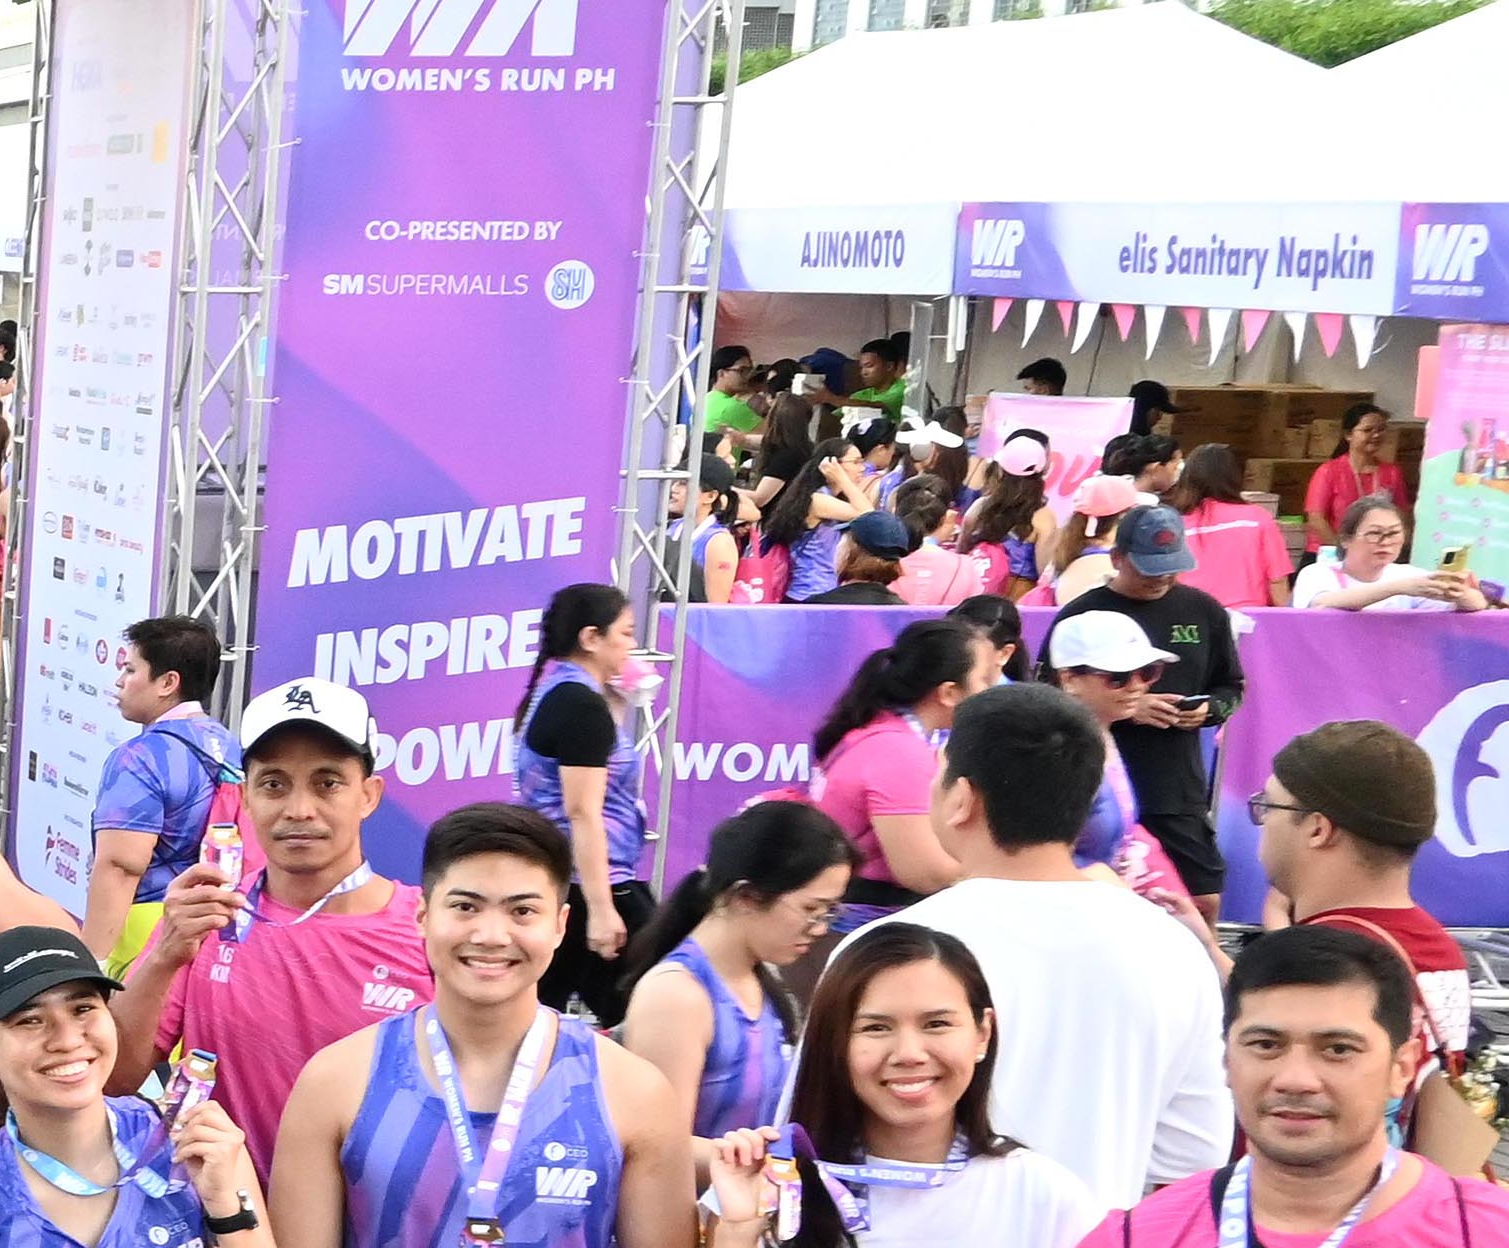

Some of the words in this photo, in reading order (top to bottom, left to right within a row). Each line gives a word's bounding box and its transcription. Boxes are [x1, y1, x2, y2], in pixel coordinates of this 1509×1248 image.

[340, 68, 491, 91] WOMEN'S
[501, 68, 564, 91] RUN
[574, 68, 615, 91] PH
[365, 220, 531, 241] CO-PRESENTED
[534, 220, 562, 241] BY
[800, 230, 905, 268] AJINOMOTO
[971, 219, 1025, 267] WR
[1119, 232, 1158, 276] elis
[1164, 233, 1269, 290] Sanitary
[1277, 234, 1375, 291] Napkin
[1412, 223, 1490, 282] WR
[287, 496, 586, 588] MOTIVATE
[313, 608, 544, 688] INSPIRE
[673, 742, 810, 782] WOM
[363, 982, 415, 1011] WR
[536, 1166, 598, 1198] WR
